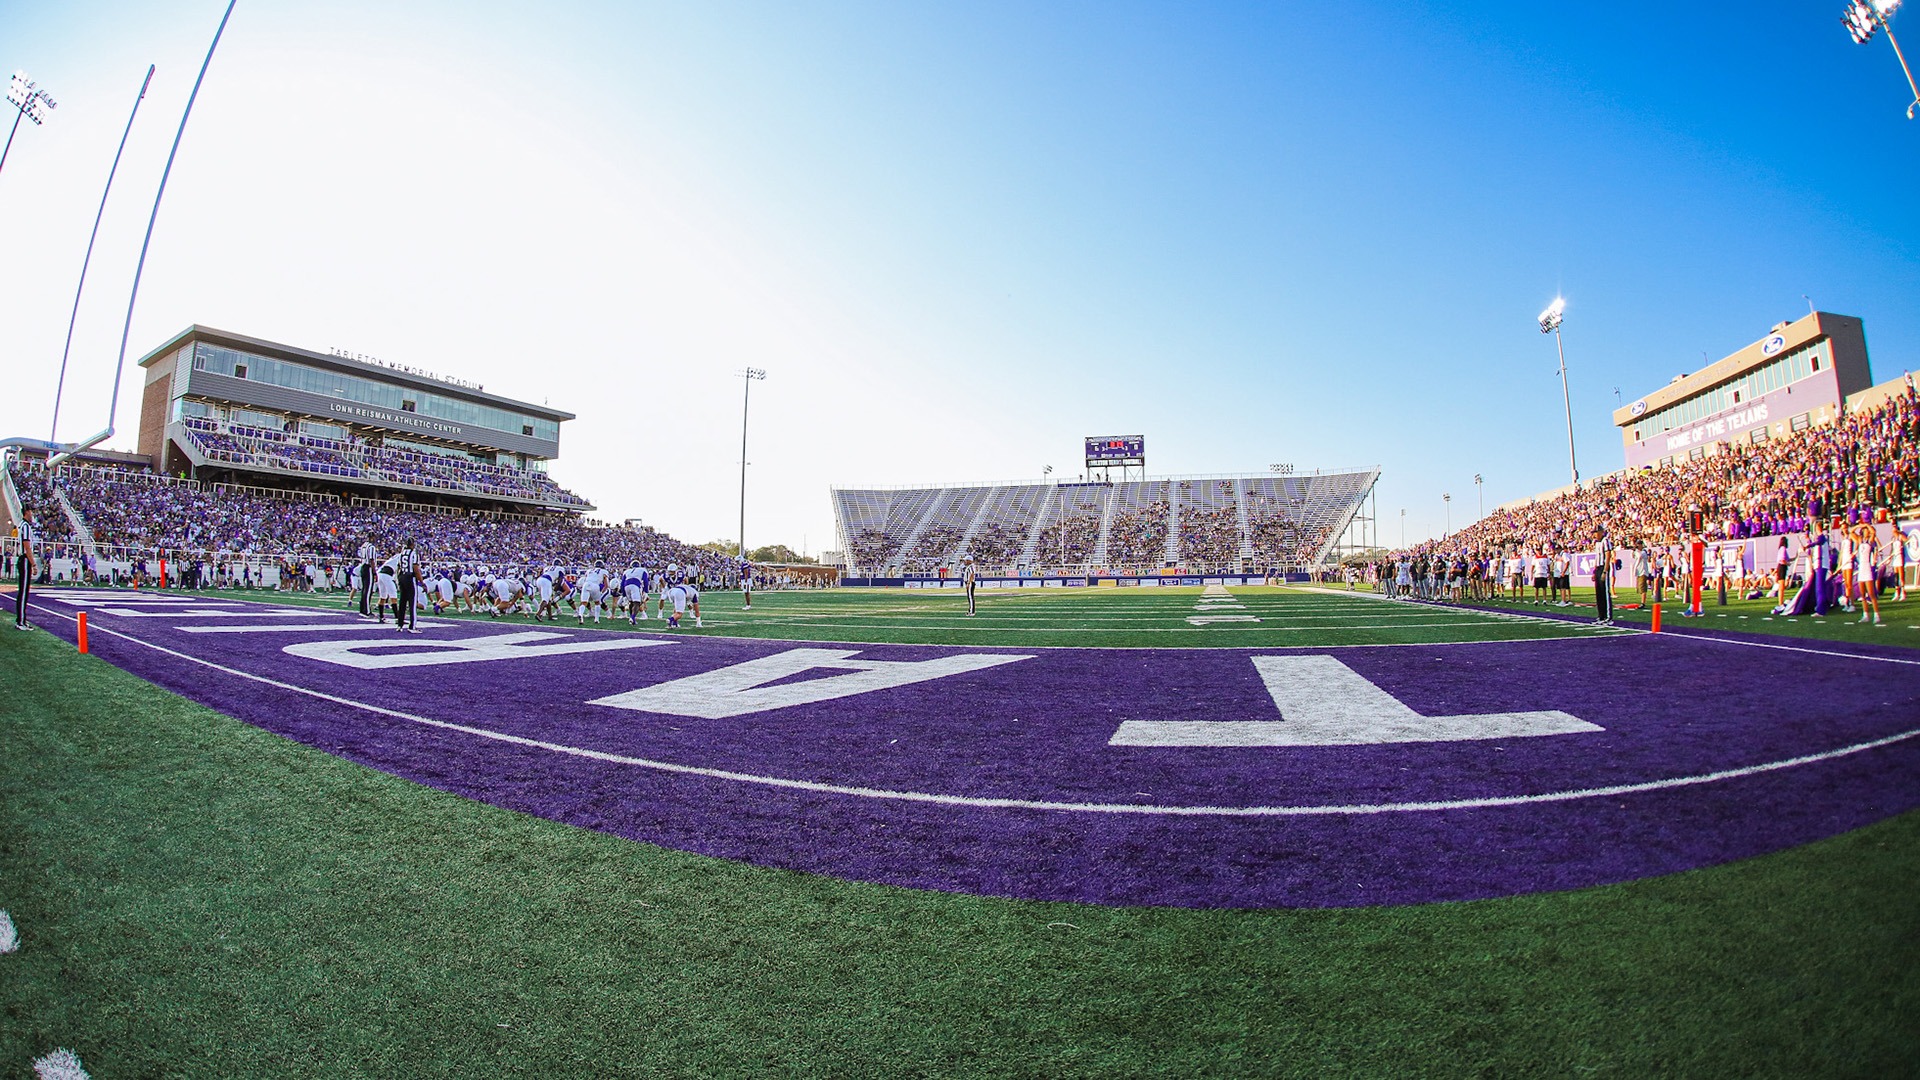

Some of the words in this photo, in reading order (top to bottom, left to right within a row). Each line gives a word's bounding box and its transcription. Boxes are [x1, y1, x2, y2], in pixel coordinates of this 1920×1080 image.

[330, 347, 383, 367] TARLETON
[389, 361, 440, 381] MEMORIAL
[444, 375, 484, 392] STADIUM
[330, 403, 353, 414] LONN
[356, 408, 391, 421] REISMAN
[394, 416, 430, 428] ATHLETIC
[433, 423, 462, 435] CENTER
[1667, 431, 1691, 451] HOME
[1692, 426, 1704, 442] OF
[1706, 419, 1726, 438] THE
[1726, 404, 1769, 431] TEXANS
[1694, 512, 1701, 531] 1
